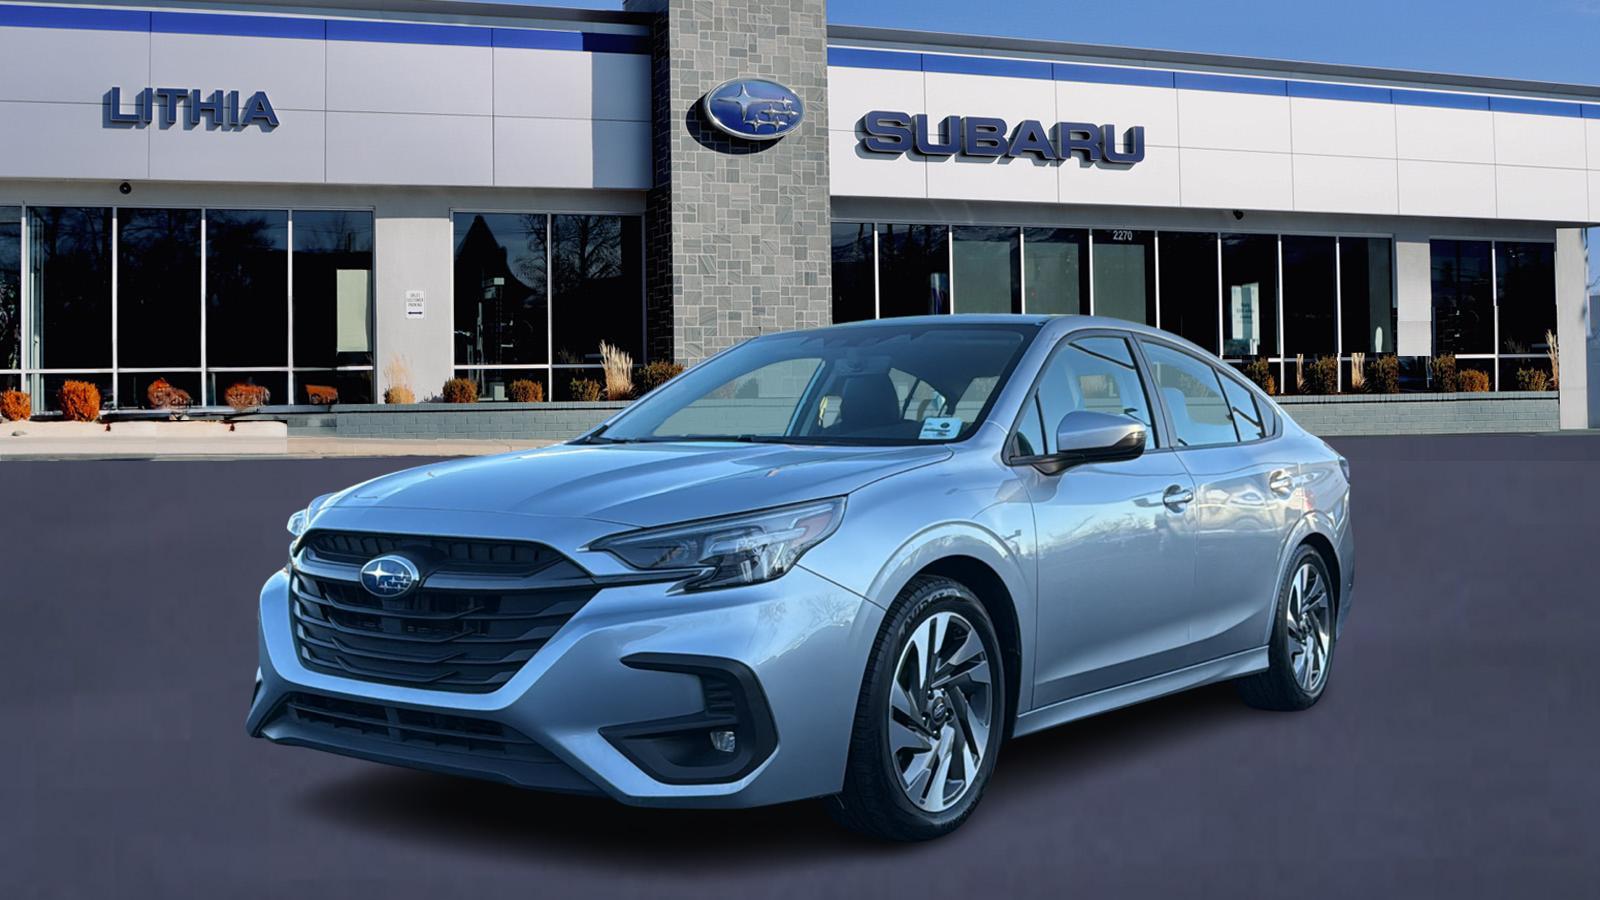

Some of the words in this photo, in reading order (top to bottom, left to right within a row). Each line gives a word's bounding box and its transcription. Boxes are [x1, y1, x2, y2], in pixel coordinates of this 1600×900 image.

[108, 86, 280, 128] LITHIA
[857, 110, 1145, 164] SUBARU
[1112, 230, 1133, 241] 2270
